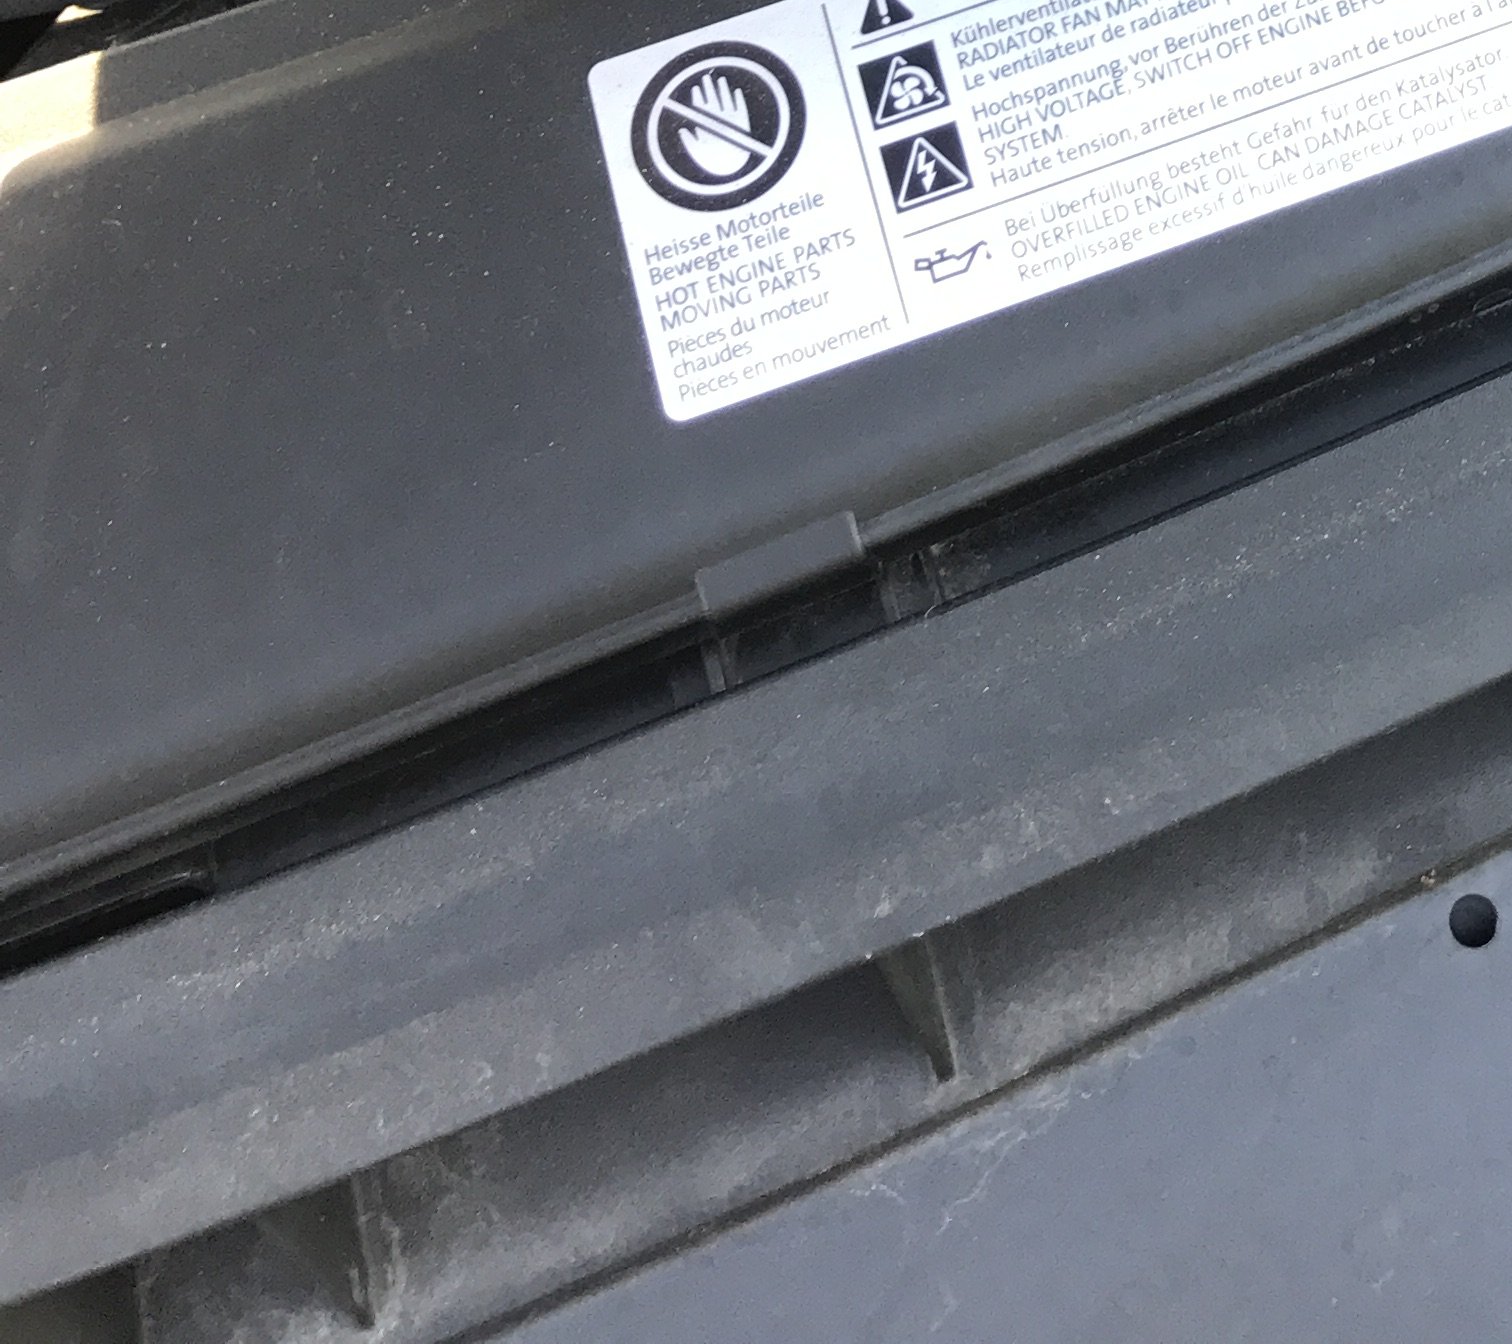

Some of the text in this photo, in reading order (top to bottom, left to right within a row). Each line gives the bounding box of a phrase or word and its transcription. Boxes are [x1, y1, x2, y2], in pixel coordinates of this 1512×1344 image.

[956, 21, 1057, 69] RADIATOR
[1060, 6, 1101, 33] FAN
[962, 73, 985, 91] Le
[988, 33, 1095, 81] ventilateur
[1101, 23, 1126, 43] de
[971, 58, 1128, 121] Hochspannung,
[1127, 44, 1159, 65] vor
[1163, 13, 1254, 54] Berühren
[1257, 0, 1286, 22] der
[977, 110, 1032, 142] HIGH
[1034, 76, 1131, 122] VOLTAGE,
[1133, 47, 1212, 88] SWITCH
[1215, 32, 1252, 59] OFF
[1256, 5, 1332, 45] ENGINE
[990, 156, 1052, 187] Haute
[1056, 127, 1137, 164] tension,
[1140, 101, 1204, 135] arrêter
[1209, 93, 1228, 110] le
[1232, 66, 1302, 102] moteur
[1308, 44, 1363, 75] avant
[1366, 35, 1390, 55] de
[1392, 9, 1465, 44] toucher
[1004, 215, 1035, 236] Bei
[1166, 140, 1241, 179] besteht
[1246, 116, 1311, 149] Gefahr
[1355, 89, 1391, 111] den
[1010, 204, 1128, 258] OVERFILLED
[1133, 174, 1210, 215] ENGINE
[1257, 143, 1300, 170] CAN
[1304, 108, 1393, 154] DAMAGE
[1017, 227, 1142, 281] Remplissage
[1148, 191, 1224, 235] excessif
[1411, 115, 1453, 144] pour
[643, 192, 824, 265] Heisse Motorteile
[648, 225, 790, 286] Bewegte Teile
[654, 227, 855, 312] HOT ENGINE PARTS
[659, 261, 820, 331] MOVING PARTS
[730, 316, 756, 336] du
[759, 290, 829, 326] moteur
[742, 361, 766, 379] en
[771, 314, 891, 369] mouvement
[673, 340, 752, 378] chaudes
